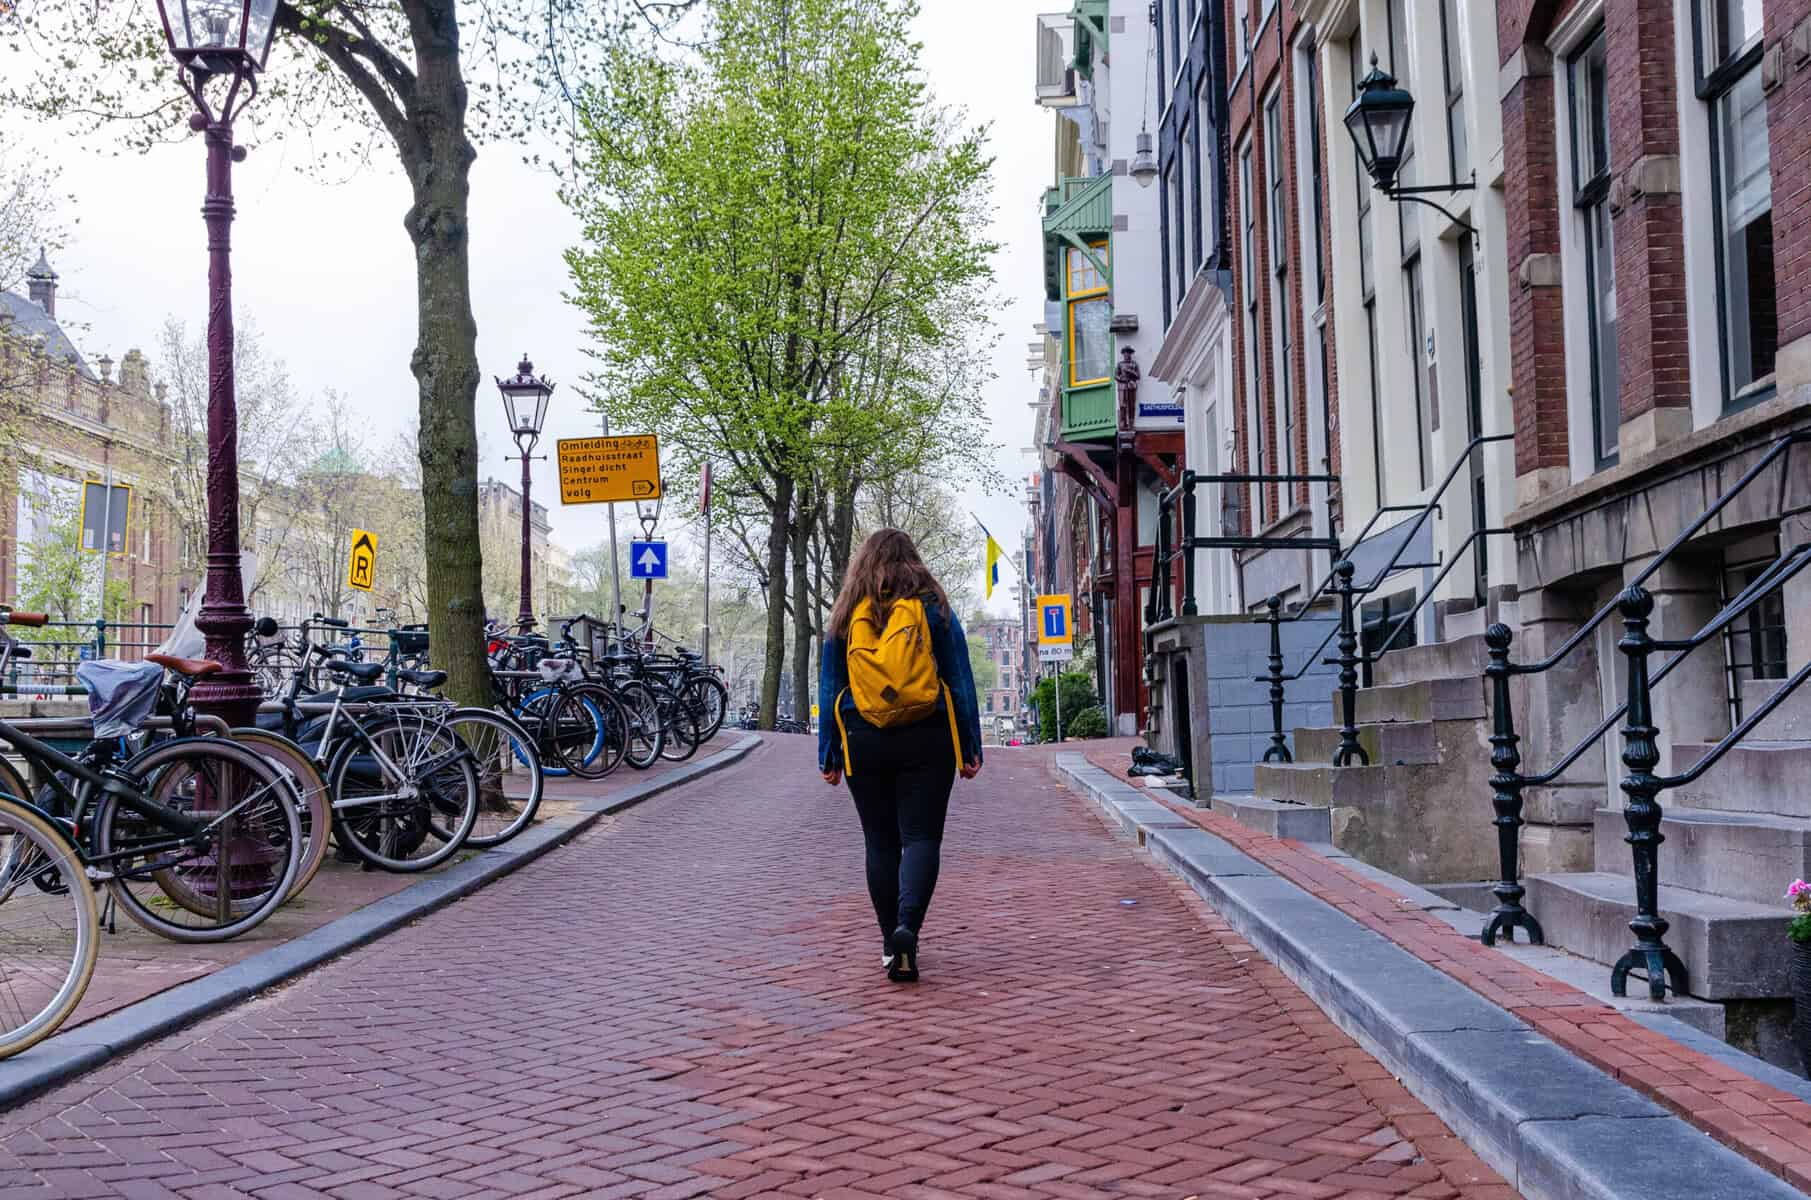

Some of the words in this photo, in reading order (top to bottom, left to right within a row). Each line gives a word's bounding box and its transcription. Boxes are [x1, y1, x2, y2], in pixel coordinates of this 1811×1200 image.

[561, 440, 619, 451] Omleiding
[562, 451, 644, 463] Raadhuisstraat
[562, 464, 596, 475] Singel
[599, 463, 627, 472] dicht
[563, 476, 609, 486] Centrum
[566, 488, 591, 498] volg
[356, 555, 368, 581] R
